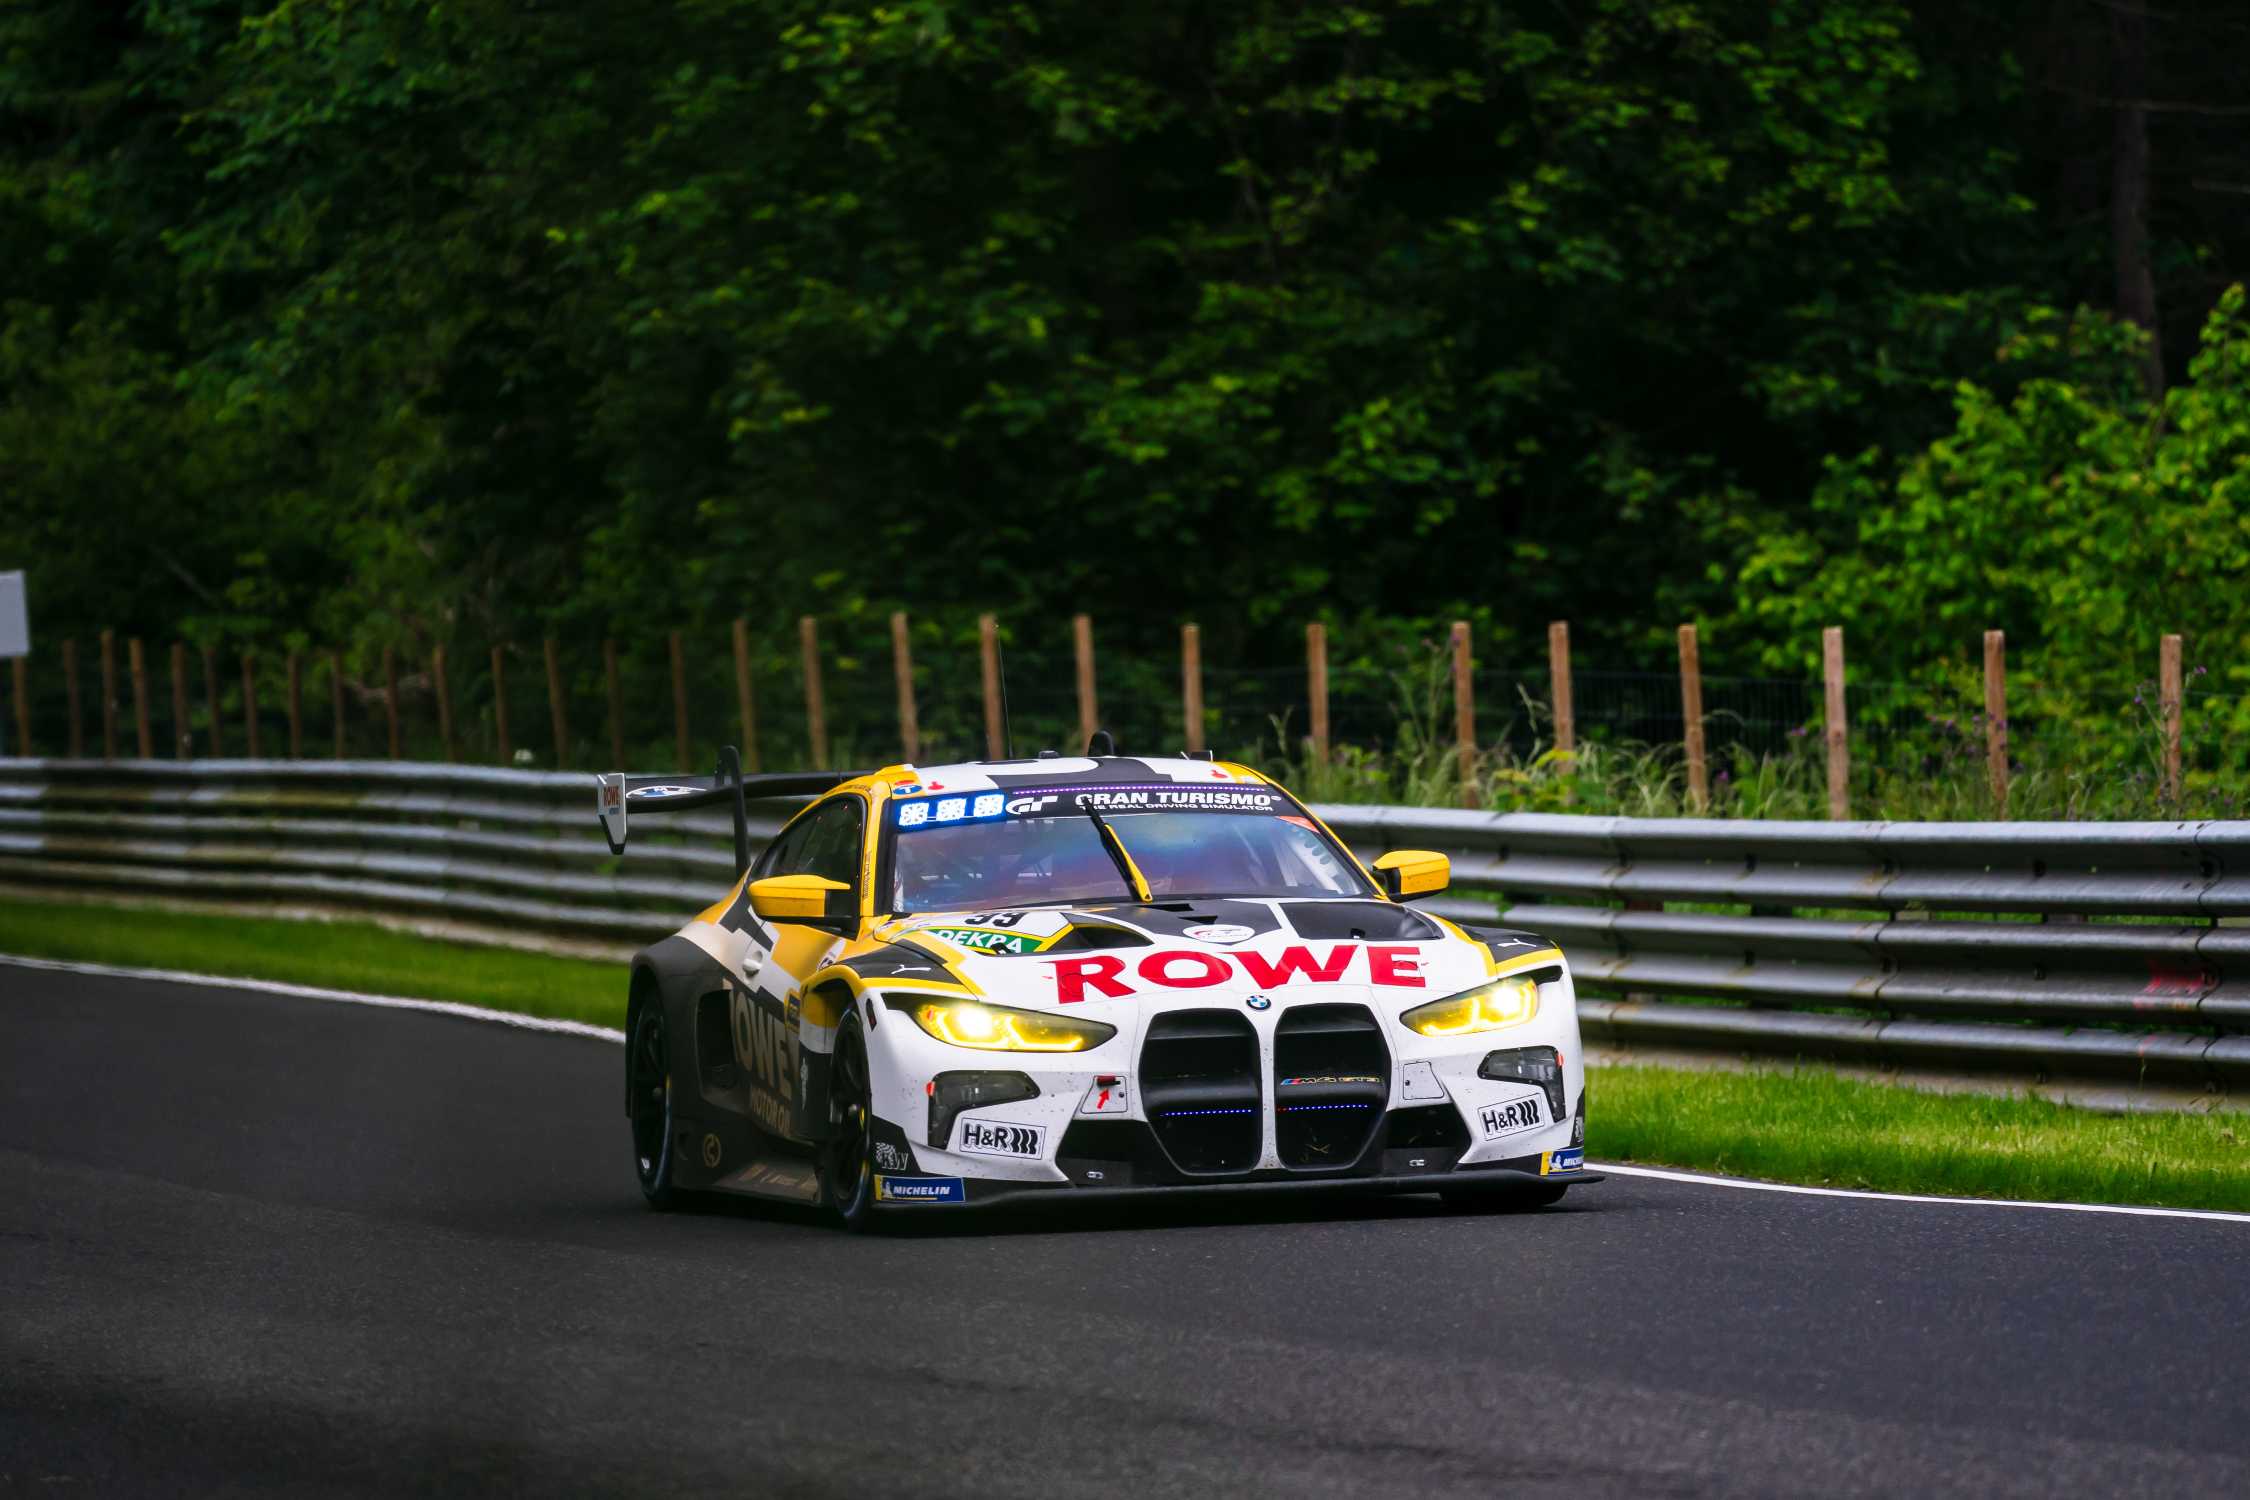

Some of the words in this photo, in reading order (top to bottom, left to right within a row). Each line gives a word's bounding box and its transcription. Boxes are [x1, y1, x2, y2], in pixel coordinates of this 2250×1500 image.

[1074, 792, 1148, 806] GRAN
[1200, 803, 1274, 812] SIMULATOR
[939, 929, 1022, 954] DEKRA
[1040, 944, 1427, 1005] ROWE
[1481, 1105, 1519, 1134] H&R
[963, 1123, 1010, 1149] H&R
[893, 1186, 951, 1195] MICHELIN
